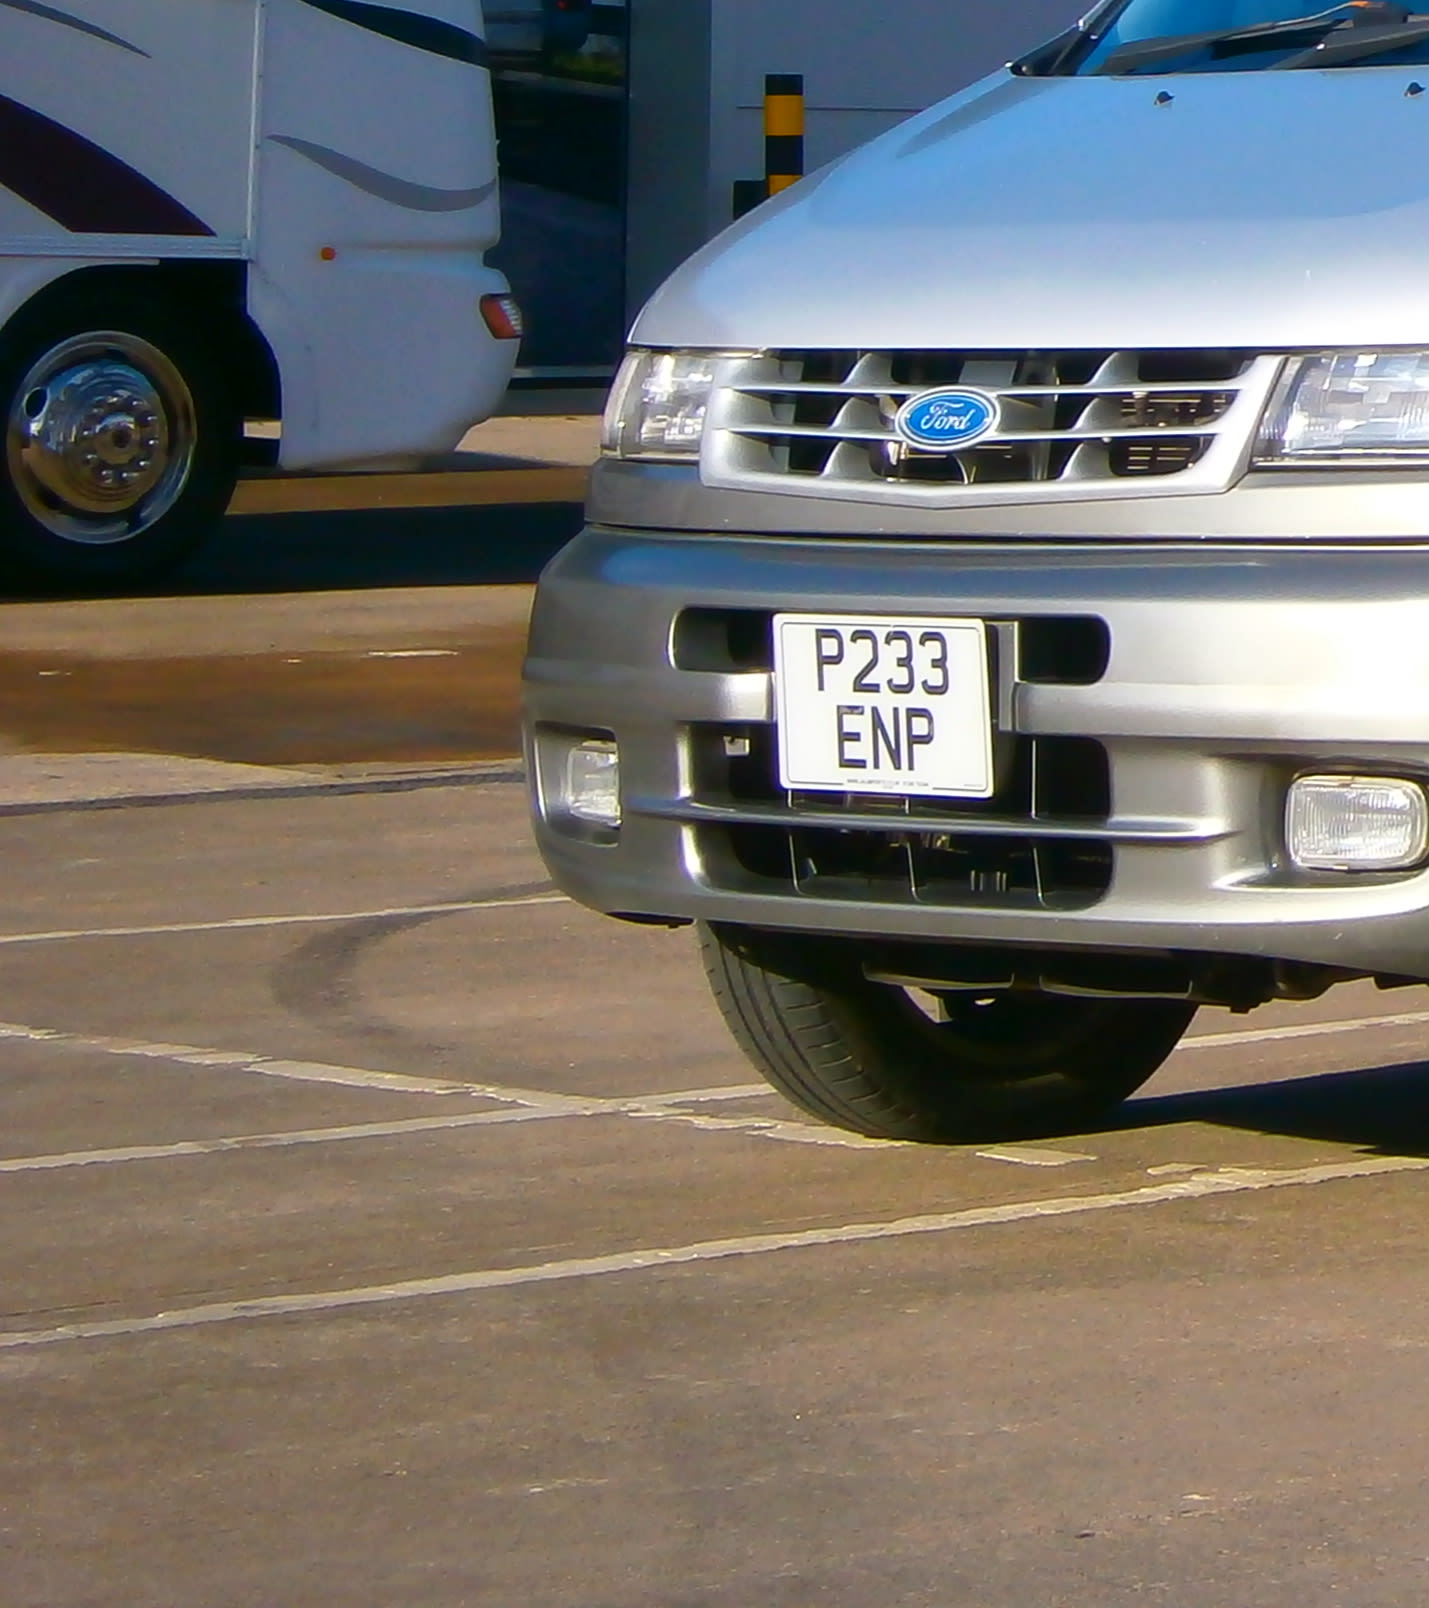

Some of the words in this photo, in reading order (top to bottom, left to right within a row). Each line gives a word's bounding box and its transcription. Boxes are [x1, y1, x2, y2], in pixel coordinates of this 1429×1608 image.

[920, 401, 976, 431] Ford
[815, 628, 949, 695] P233
[836, 705, 935, 771] ENP
